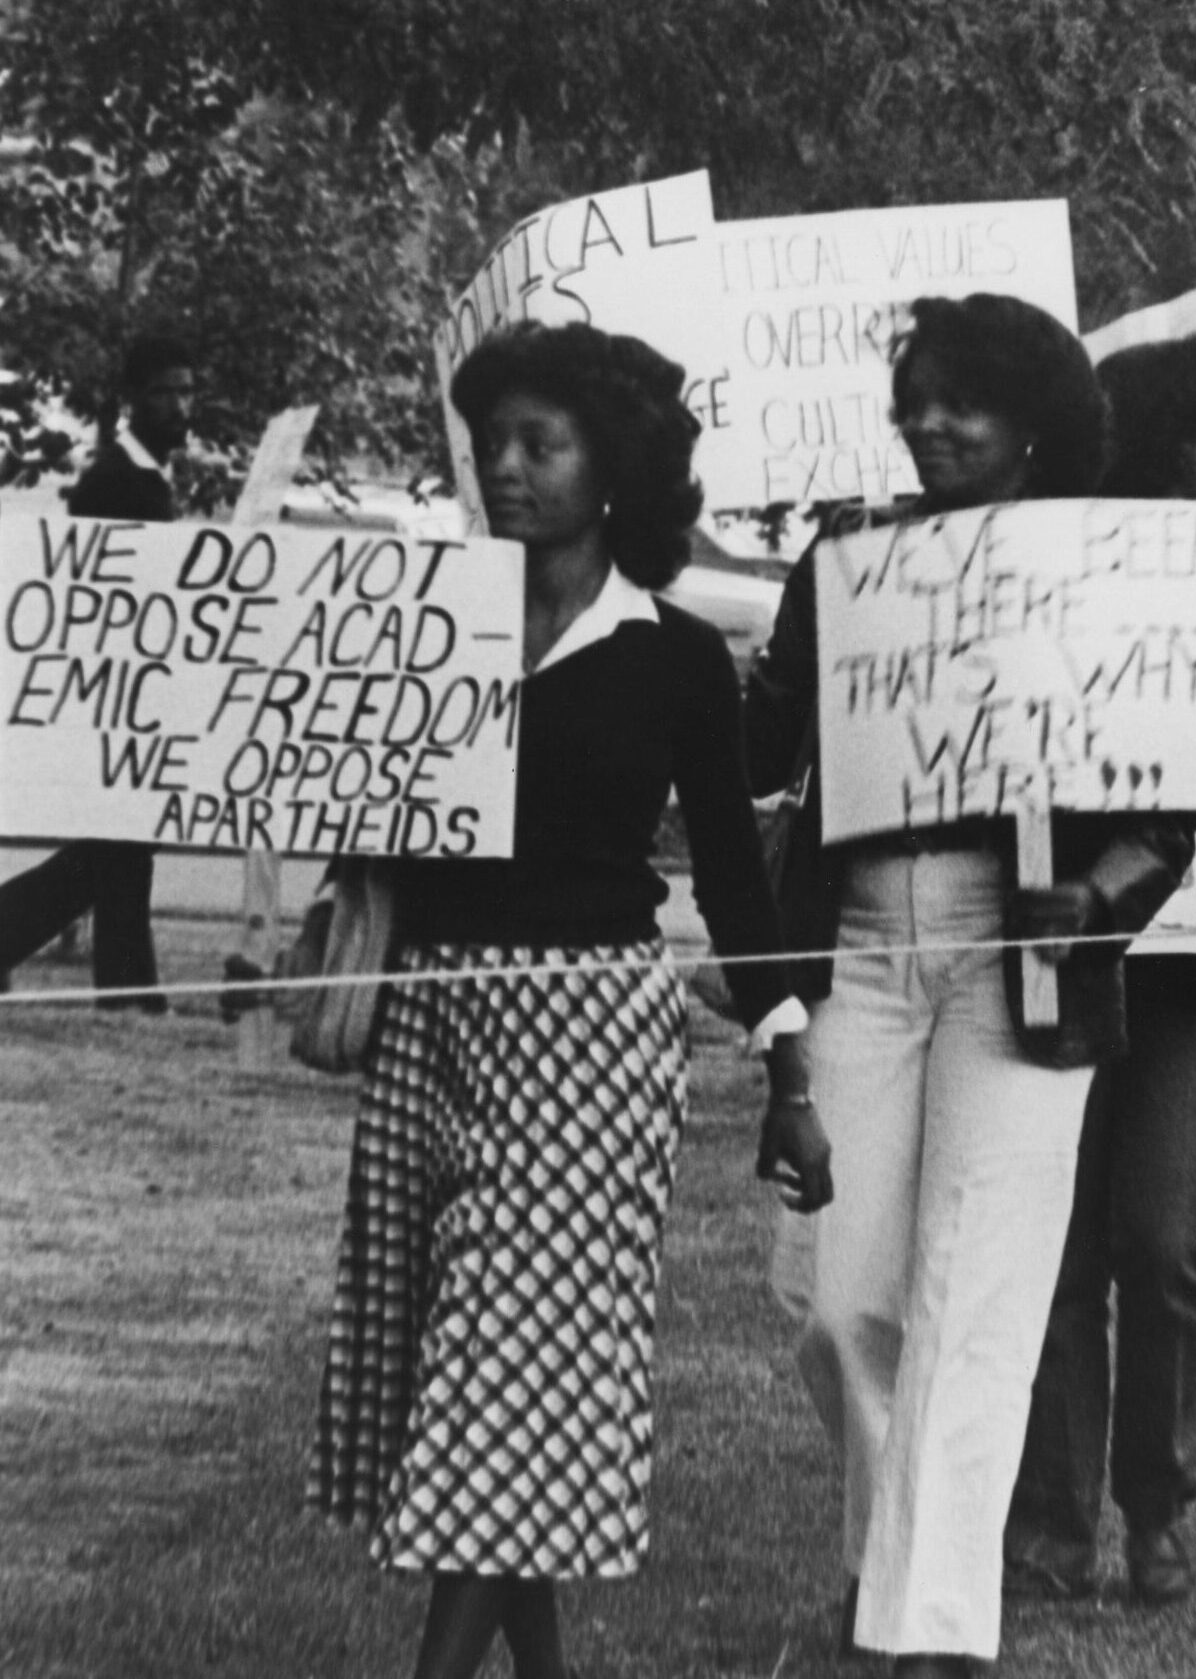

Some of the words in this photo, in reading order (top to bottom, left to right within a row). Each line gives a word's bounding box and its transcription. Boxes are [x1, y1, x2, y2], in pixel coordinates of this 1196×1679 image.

[878, 217, 1018, 279] VALUES
[40, 518, 145, 583] WE
[176, 528, 277, 593] DO
[296, 536, 467, 601] NOT
[6, 580, 279, 664] OPPOSE
[7, 654, 172, 733] EMIC
[207, 667, 522, 749] FREEDOM
[102, 731, 199, 792] WE
[223, 739, 454, 804] OPPOSE
[155, 791, 481, 857] APARTHEIDS
